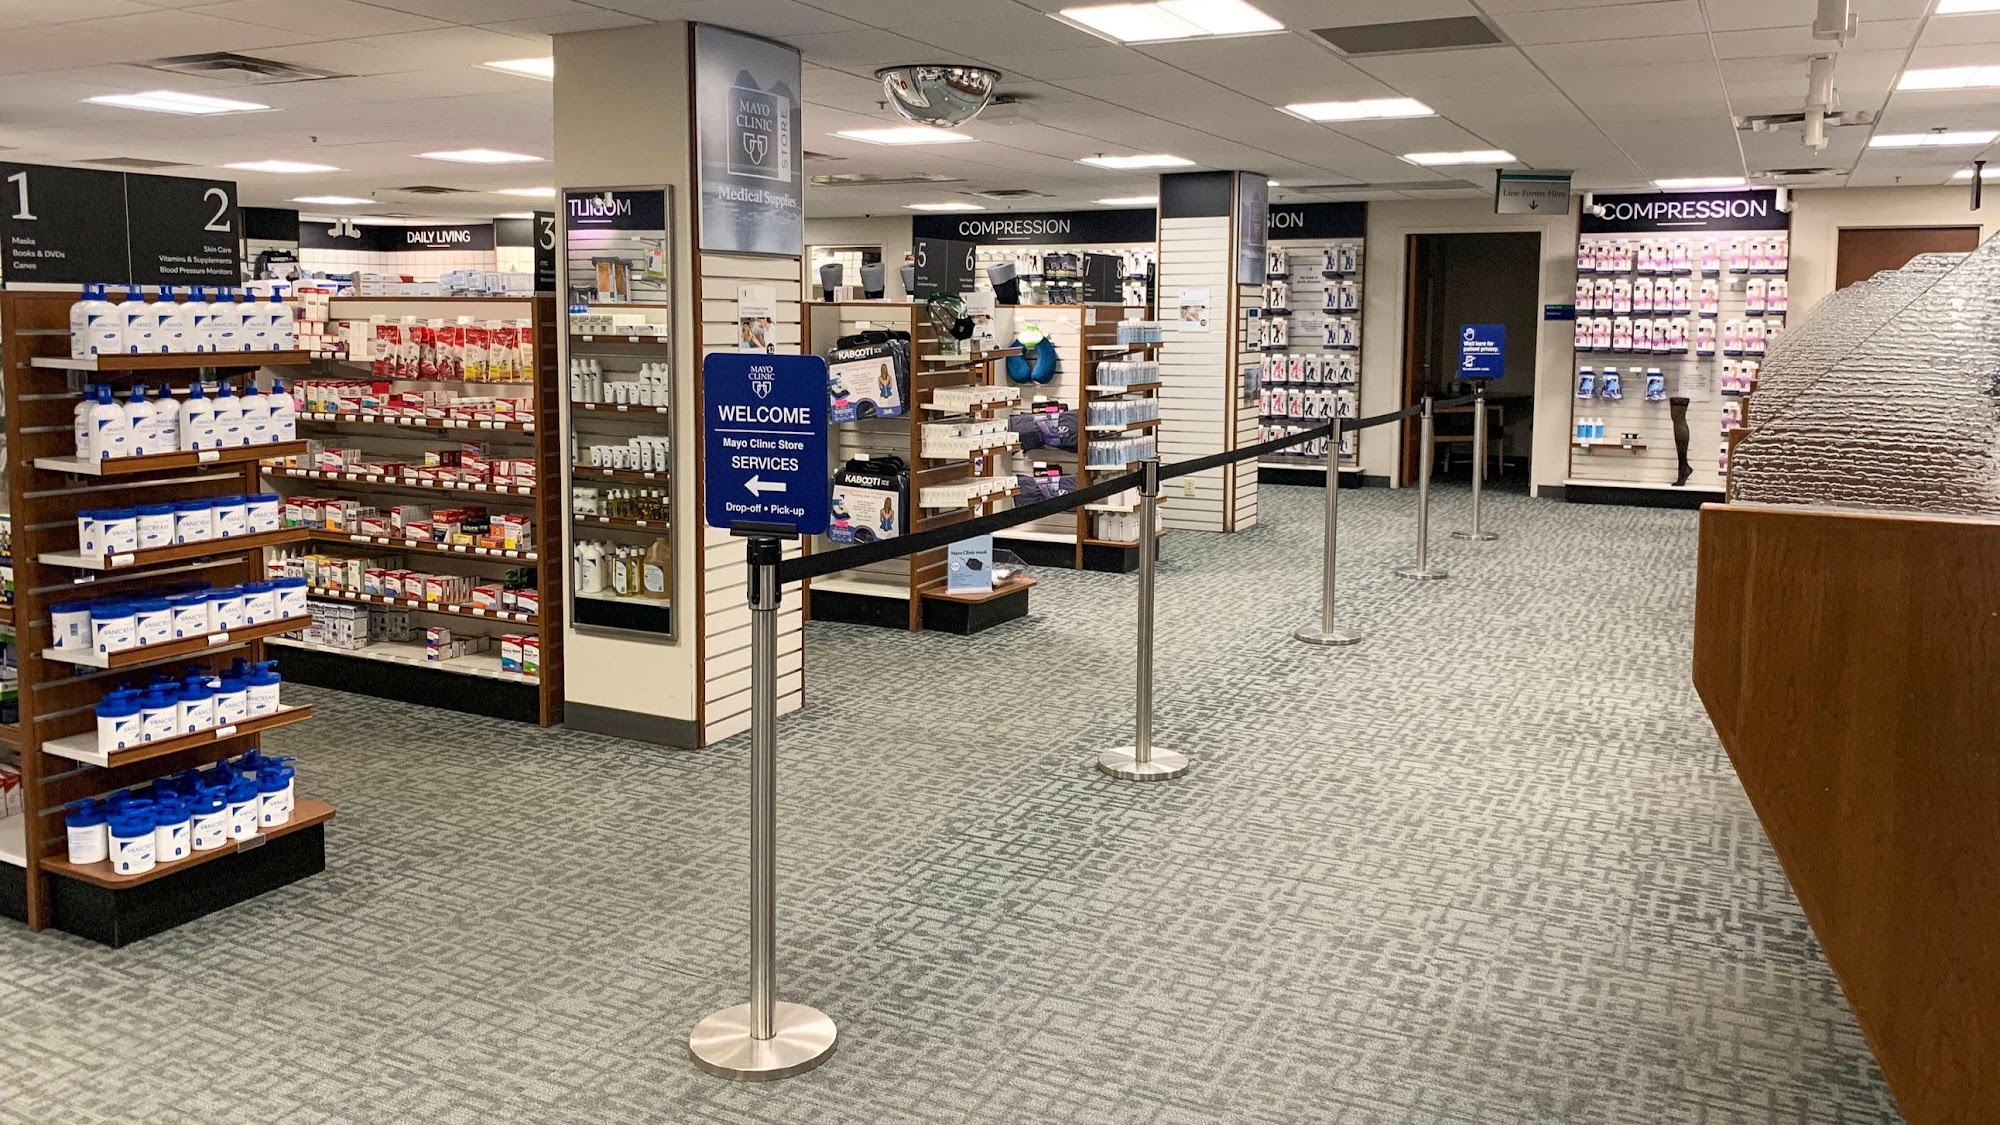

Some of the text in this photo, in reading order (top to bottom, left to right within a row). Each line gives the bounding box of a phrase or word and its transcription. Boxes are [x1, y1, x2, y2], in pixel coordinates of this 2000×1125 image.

[740, 100, 771, 117] MAYO
[736, 114, 772, 132] CLINIC
[780, 108, 788, 170] STORE
[7, 171, 38, 220] 1
[718, 186, 797, 209] Medical Supplies
[1503, 189, 1520, 197] Line
[1547, 190, 1566, 198] Here
[203, 188, 232, 232] 2
[1601, 199, 1768, 222] COMPRESSION
[540, 216, 555, 250] 3
[958, 219, 1071, 236] COMPRESSION
[12, 236, 36, 245] Masks
[407, 230, 470, 244] DAILY LIVING
[12, 249, 66, 258] Books & DVDs
[158, 255, 186, 264] Vitamins
[193, 256, 232, 266] Supplements
[918, 242, 927, 268] 5
[966, 246, 974, 272] 6
[14, 262, 37, 270] Canes
[160, 266, 178, 274] Blood
[206, 268, 233, 276] Monitors
[1084, 256, 1092, 276] 7
[1116, 259, 1122, 280] 8
[1148, 264, 1154, 282] 9
[838, 347, 874, 360] KABOOTI
[748, 372, 775, 380] CLINIC
[718, 405, 810, 424] WELCOME
[723, 437, 804, 450] Mayo Clinic Store
[731, 456, 799, 471] SERVICES
[844, 474, 881, 486] KABOOTI
[726, 502, 805, 517] Drop-off Pick-up
